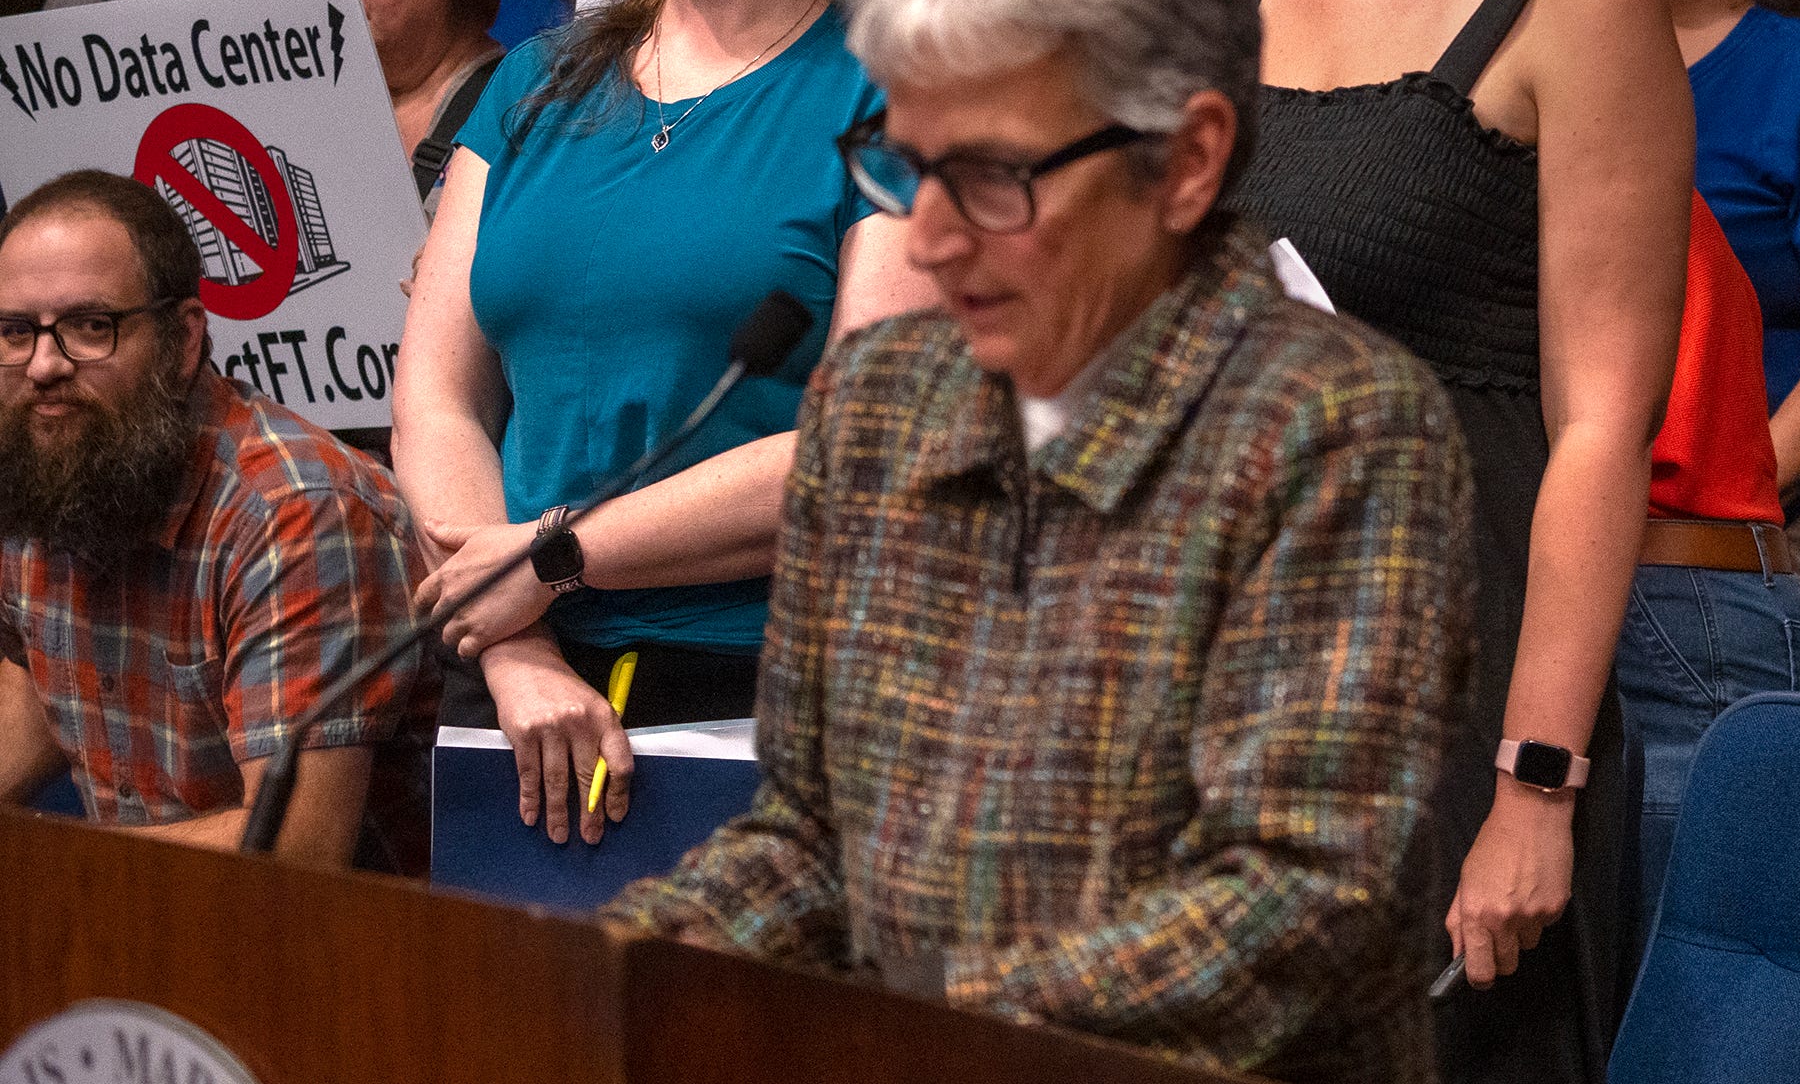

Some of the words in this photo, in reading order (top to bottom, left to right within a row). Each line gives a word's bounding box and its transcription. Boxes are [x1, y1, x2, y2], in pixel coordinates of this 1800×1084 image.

[15, 42, 82, 111] No
[82, 33, 191, 103] Data
[190, 18, 326, 89] Center
[210, 326, 398, 406] tFT.Co
